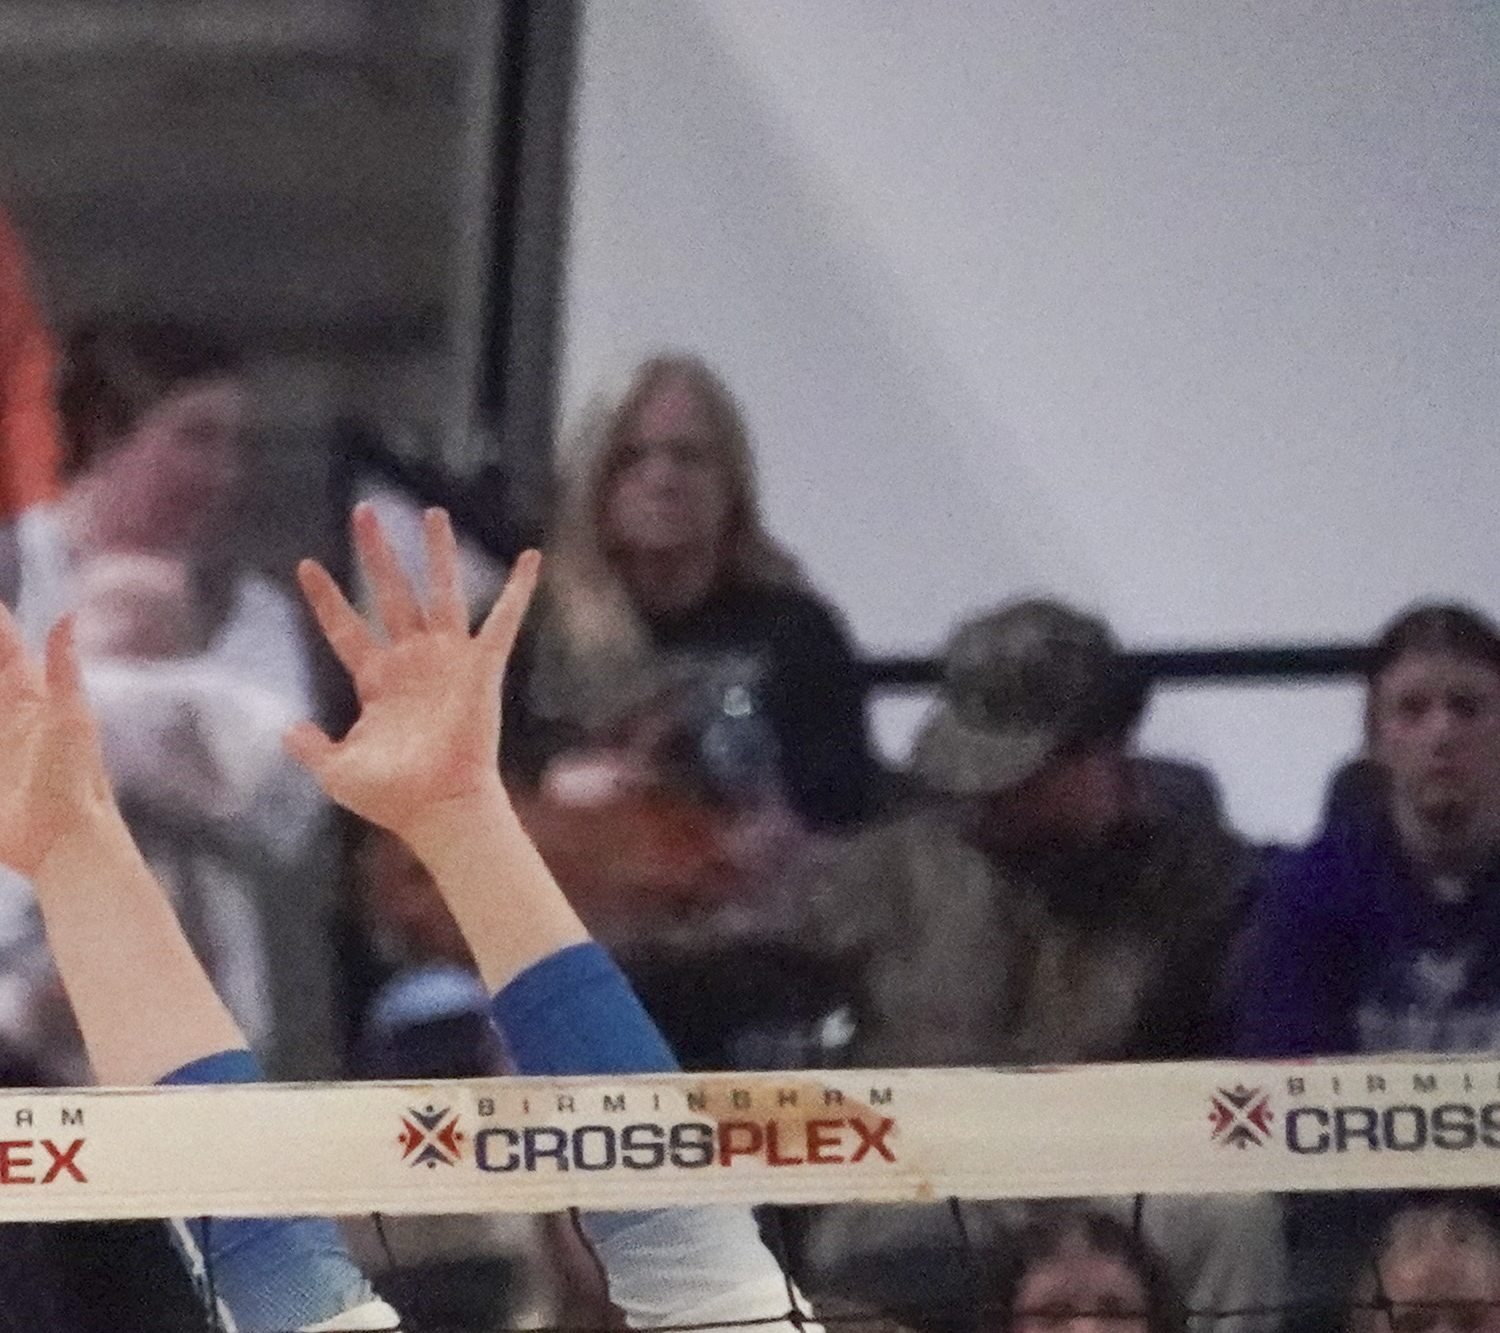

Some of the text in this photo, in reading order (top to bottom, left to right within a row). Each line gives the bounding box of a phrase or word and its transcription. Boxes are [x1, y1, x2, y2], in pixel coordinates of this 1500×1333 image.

[1286, 1071, 1500, 1096] BIRMI
[477, 1086, 893, 1117] BIRMINGHAM
[474, 1116, 896, 1173] CROSSPLEX
